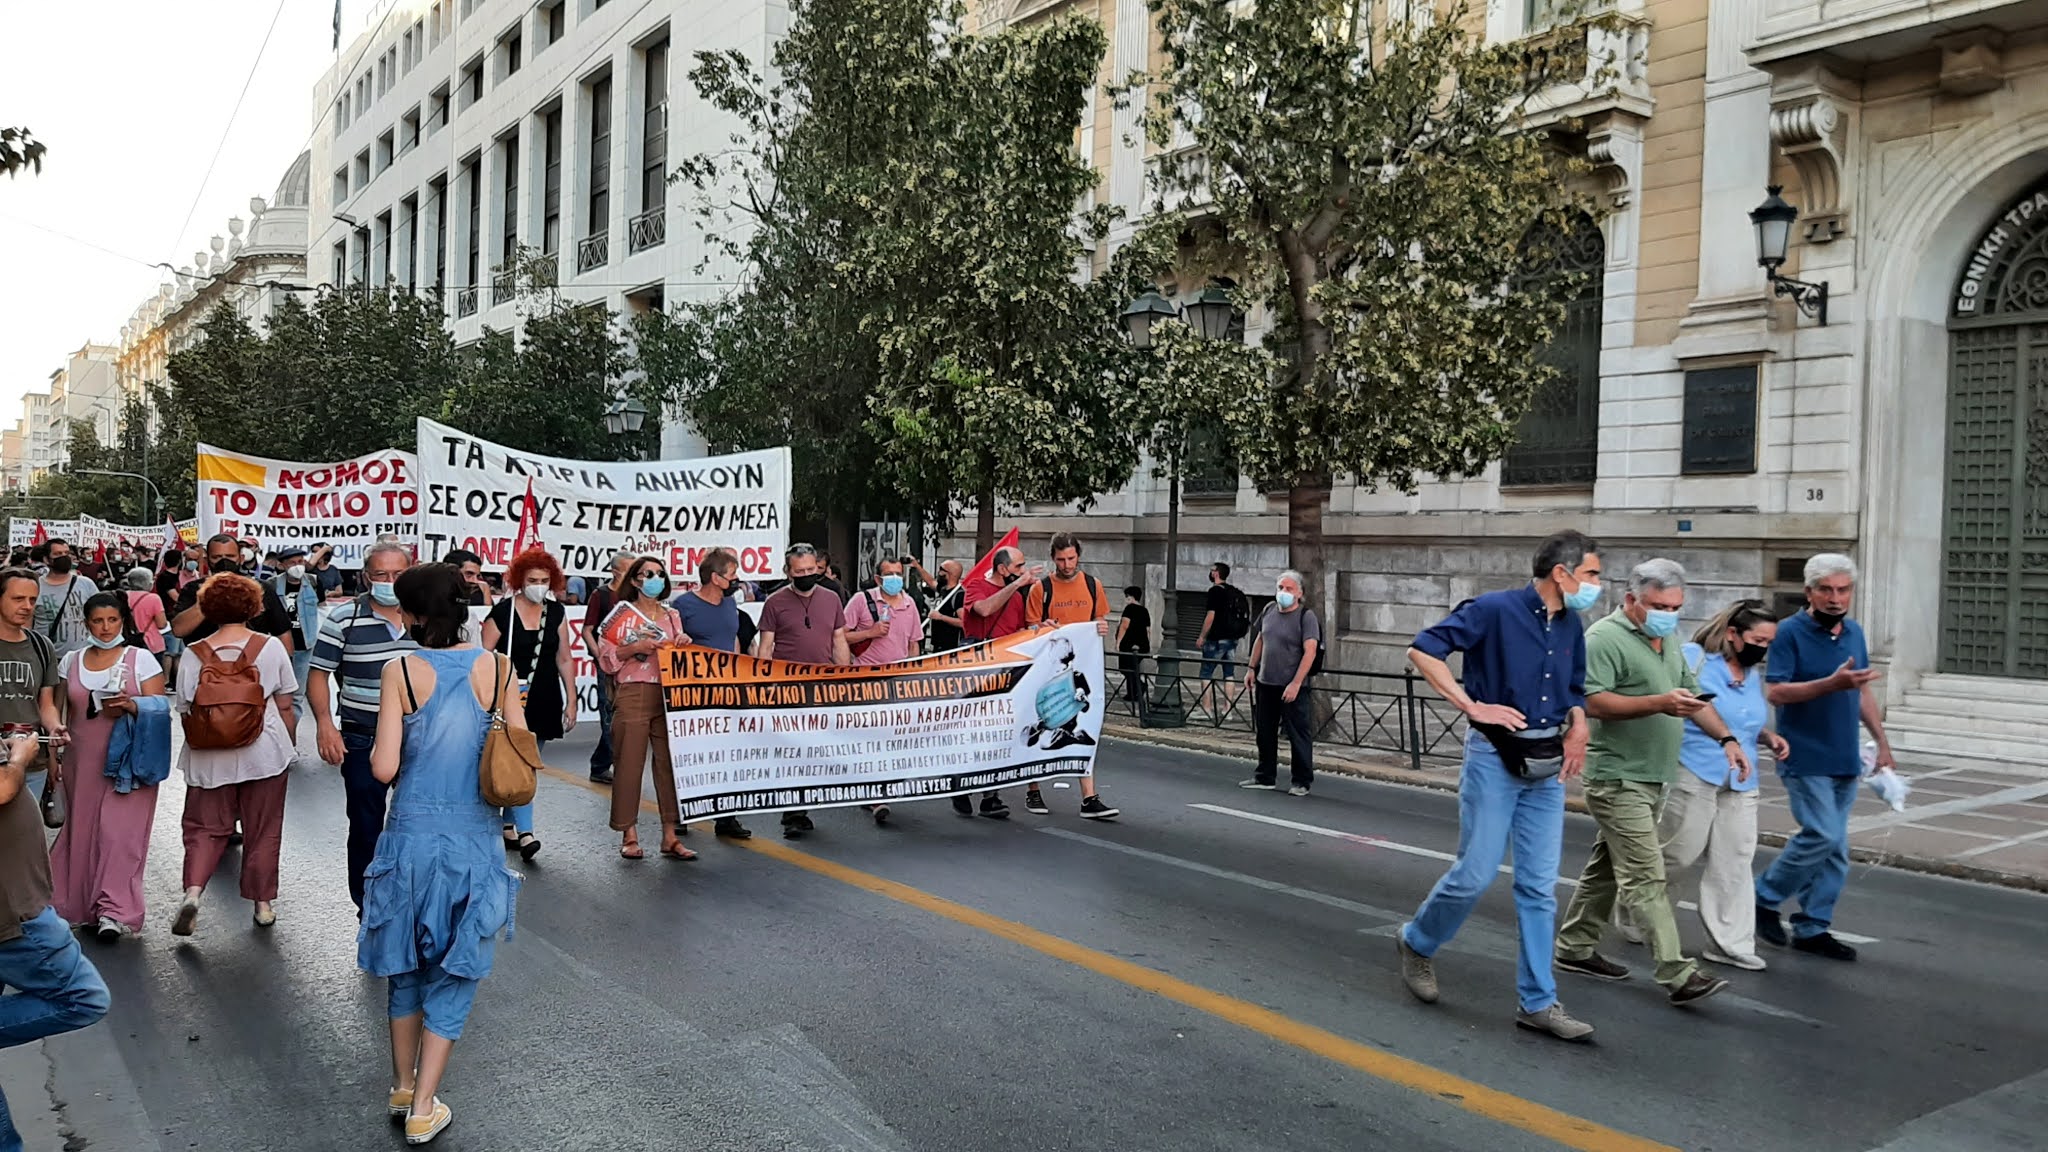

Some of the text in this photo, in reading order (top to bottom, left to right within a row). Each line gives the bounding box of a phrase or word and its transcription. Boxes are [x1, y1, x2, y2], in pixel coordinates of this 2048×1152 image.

[1957, 226, 2009, 312] ΕΘΝΙΚΗ
[278, 459, 406, 490] ΝΟΜΟΣ
[442, 436, 764, 492] ΤΑ ΚΤΙΡΙΑ ΑΝΗΚΟΥΝ
[209, 488, 257, 516] ΤΟ
[268, 491, 371, 519] ΔΙΚΙΟ
[429, 484, 779, 532] ΣΕ ΟΣΟΥΣ ΣΤΕΓΑΖΟΥΝ ΜΕΣΑ
[1806, 488, 1824, 501] 38
[244, 523, 370, 539] ΣΥΝΤΟΝΙΣΜΟΣ
[561, 544, 618, 573] ΤΟΥΣ
[670, 546, 772, 576] ΕΜΟΣ
[746, 685, 806, 706] ΜΑΖΙΚΟΙ
[814, 681, 889, 704] ΔΙΟΡΙΣΜΟΙ
[895, 673, 1012, 699] ΕΚΠΑΙΔΕΥΤΙΚΩΝ!
[738, 716, 764, 733] ΚΑΙ
[772, 713, 829, 733] ΜΟΝΙΜΟ
[836, 709, 911, 730] ΠΡΟΣΩΠΙΚΟ
[917, 699, 1014, 723] ΚΑΘΑΡΙΟΤΗΤΑΣ
[674, 752, 704, 768] ΔΩΡΕΑΝ
[709, 750, 725, 764] ΚΑΙ
[731, 747, 769, 761] ΕΠΑΡΚΗ
[774, 746, 802, 759] ΜΕΣΑ
[807, 743, 862, 758] ΠΡΟΣΤΑΣΙΑΣ
[867, 741, 882, 753] ΓΙΑ
[677, 771, 728, 789] ΔΥΝΑΤΟΤΗΤΑ
[733, 768, 770, 782] ΔΩΡΕΑΝ
[775, 764, 848, 779] ΔΙΑΓΝΩΣΤΙΚΩΝ
[853, 762, 873, 774] ΤΕΣΤ
[878, 759, 888, 772] ΣΕ
[717, 790, 800, 811] ΕΚΠΑΙΔΕΥΤΙΚΩΝ
[804, 784, 883, 803] ΠΡΩΤΟΒΑΘΜΙΑΣ
[886, 778, 952, 796] ΕΚΠΑΙΔΕΥΣΗΣ
